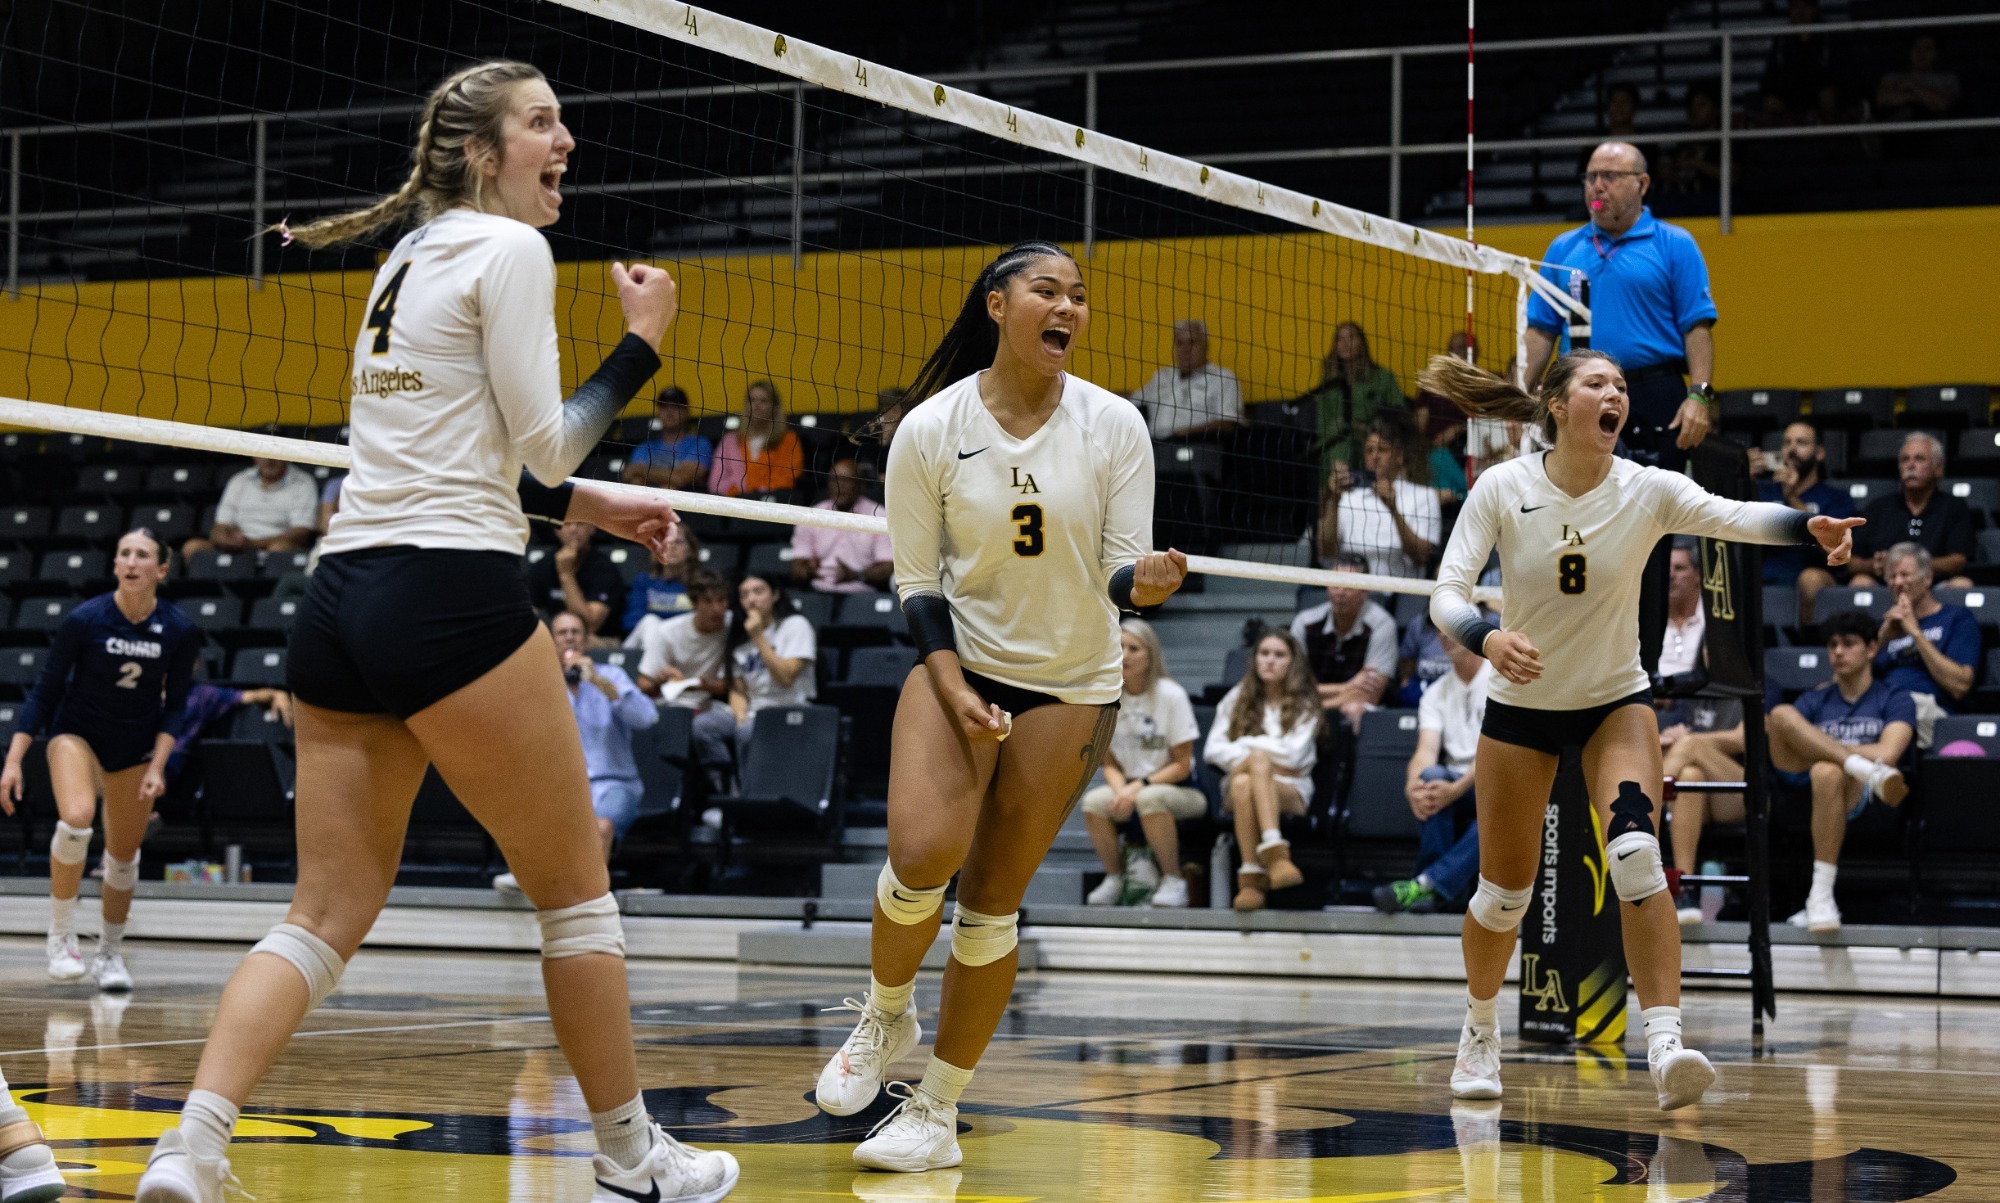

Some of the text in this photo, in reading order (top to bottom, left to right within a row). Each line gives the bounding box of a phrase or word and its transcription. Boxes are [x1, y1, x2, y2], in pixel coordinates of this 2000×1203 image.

[684, 5, 698, 36] LA
[855, 58, 868, 87] LA
[1006, 106, 1017, 133] LA
[366, 259, 414, 357] 4
[359, 366, 423, 399] Angeles
[1010, 466, 1042, 494] LA
[1009, 501, 1046, 559] 3
[1560, 524, 1586, 546] LA
[1558, 551, 1588, 596] 8
[1700, 536, 1735, 620] LA
[105, 636, 162, 659] CSUMB
[115, 661, 143, 690] 2
[1541, 803, 1559, 945] sports imports
[1521, 953, 1570, 1013] LA
